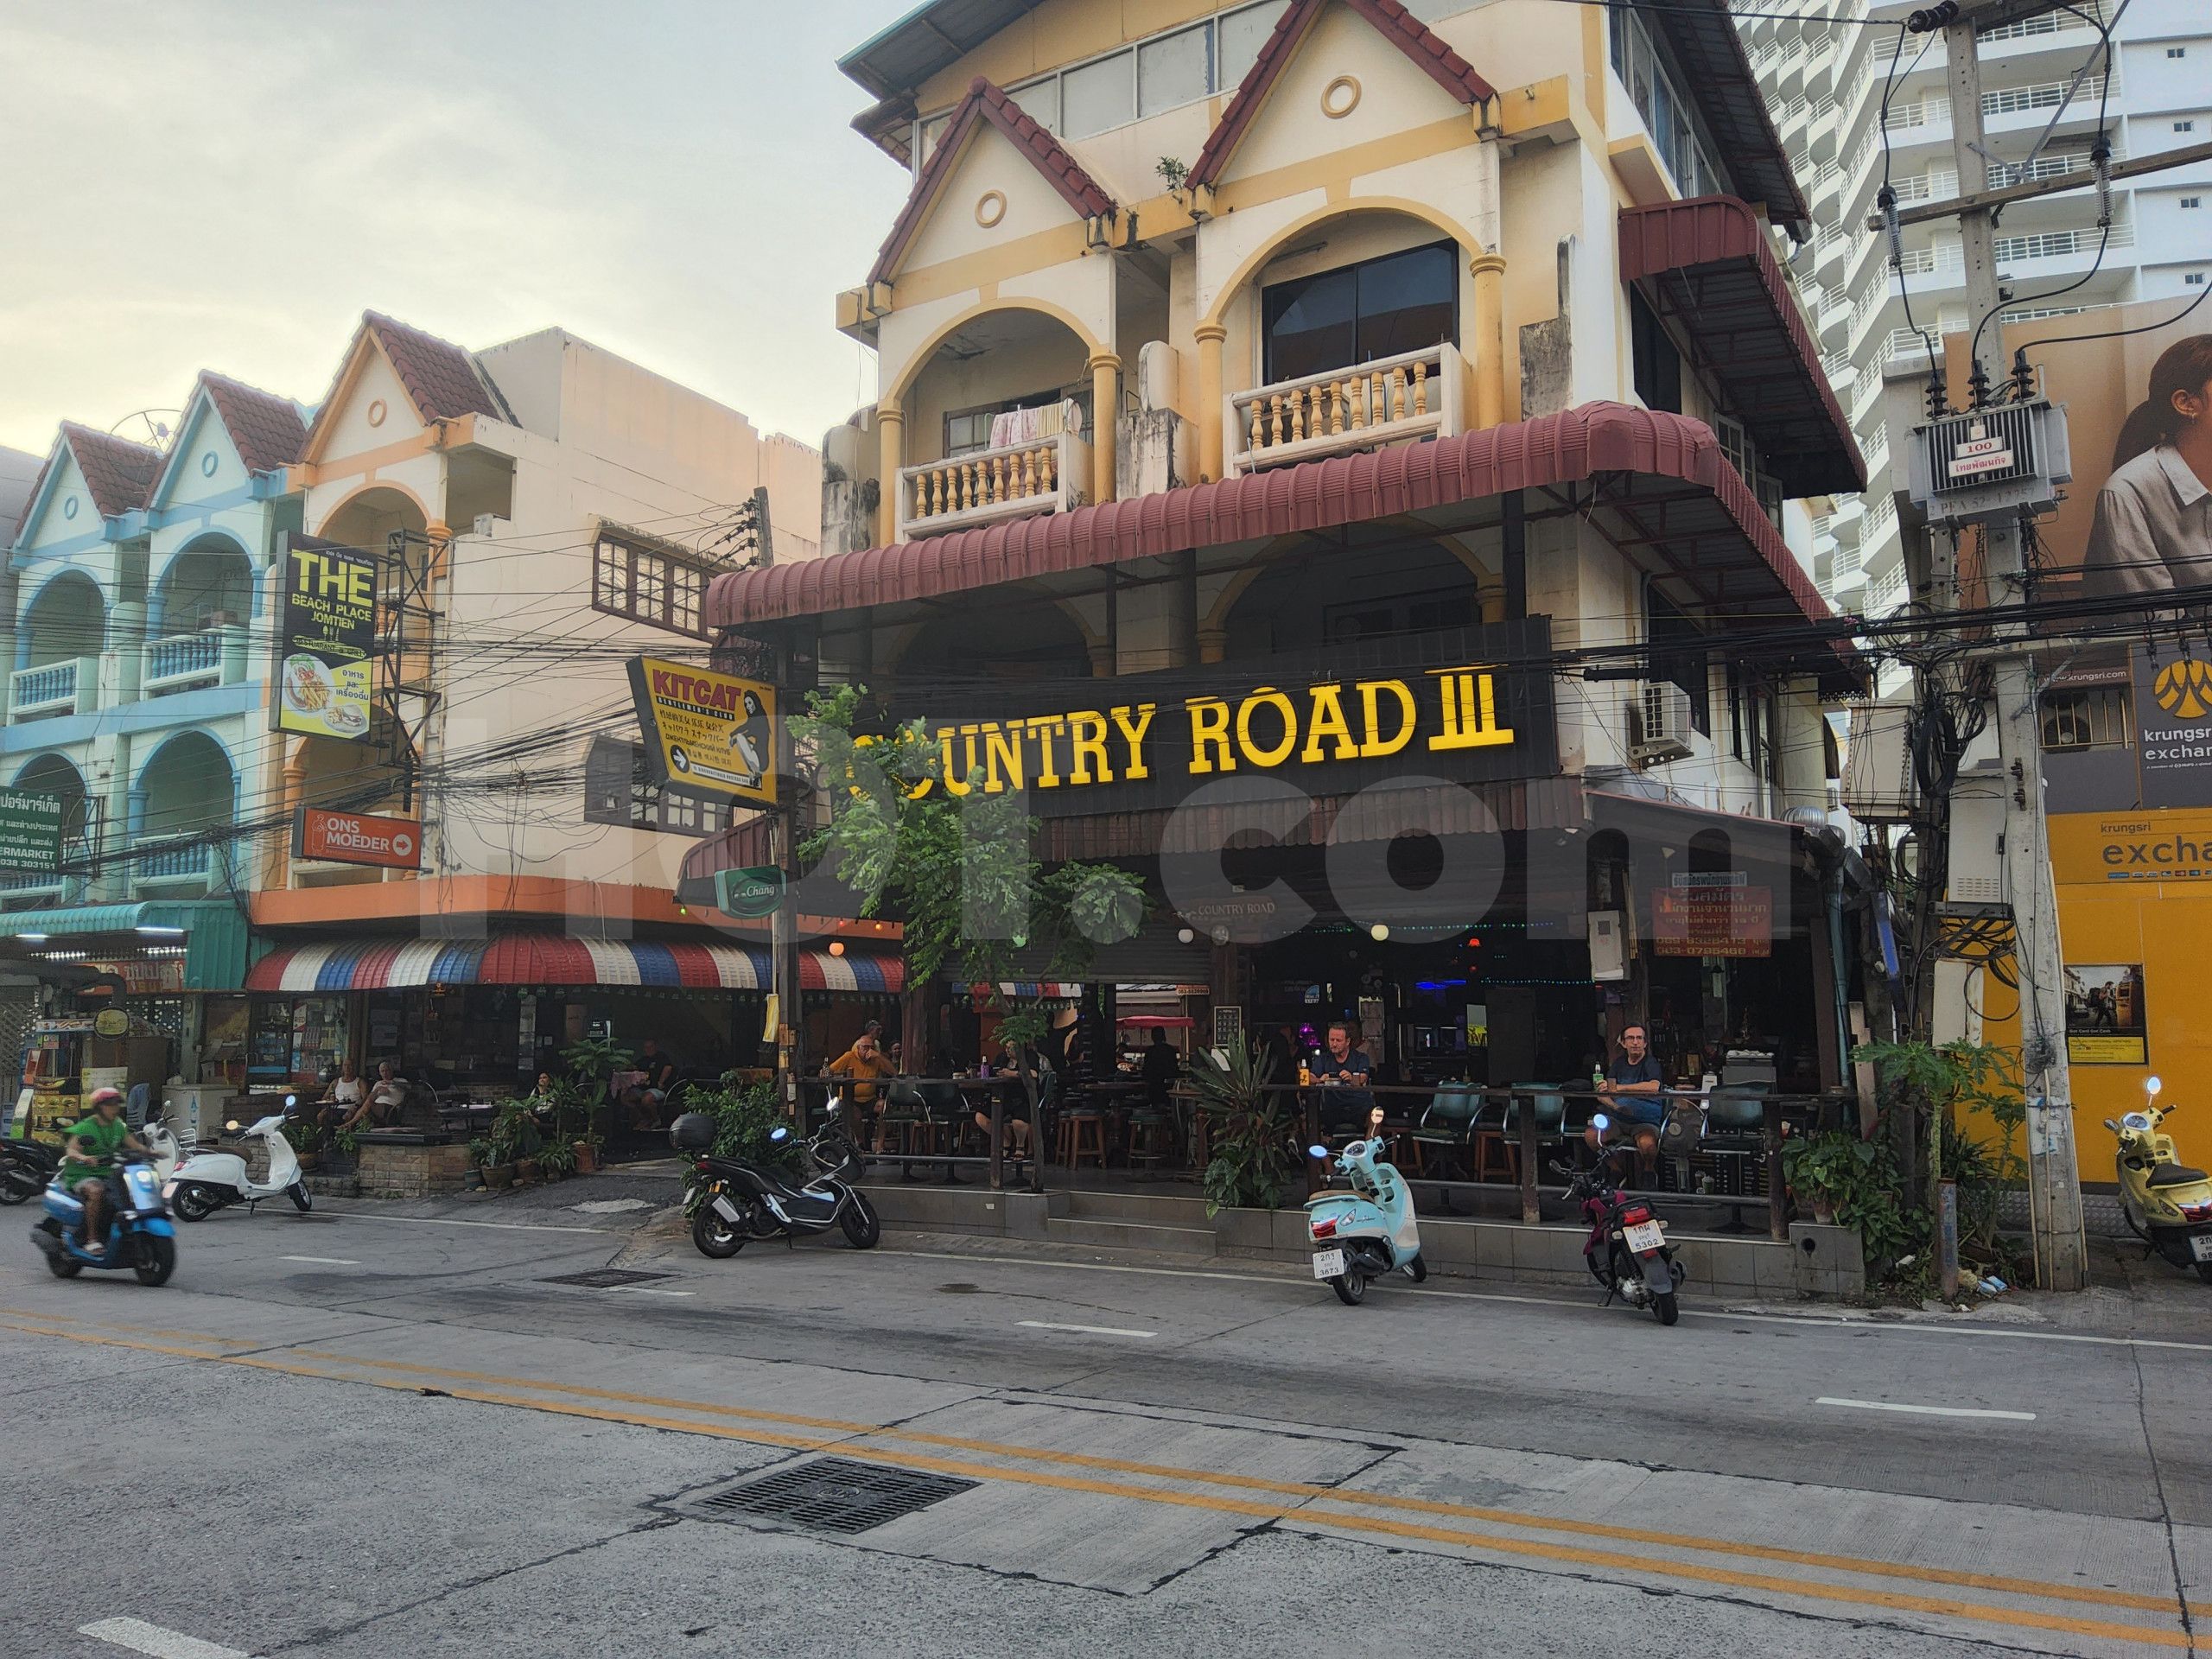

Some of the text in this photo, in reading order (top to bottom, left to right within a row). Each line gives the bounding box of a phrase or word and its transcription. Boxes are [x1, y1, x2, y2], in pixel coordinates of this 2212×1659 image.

[1967, 442, 1992, 453] 100
[291, 548, 374, 607] THE
[291, 593, 372, 622] BEACH PLACE
[310, 610, 355, 630] JOMTIEN
[652, 669, 741, 712] KITCAT
[714, 709, 734, 721] CLUB
[1185, 678, 1417, 773] ROAD
[327, 817, 360, 834] ONS
[2101, 821, 2152, 834] krungsri
[326, 832, 390, 851] MOEDER
[0, 858, 55, 870] 038 303151
[747, 885, 775, 897] Chang
[1198, 902, 1275, 915] COUNTRY ROAD
[1635, 1238, 1660, 1249] 5302
